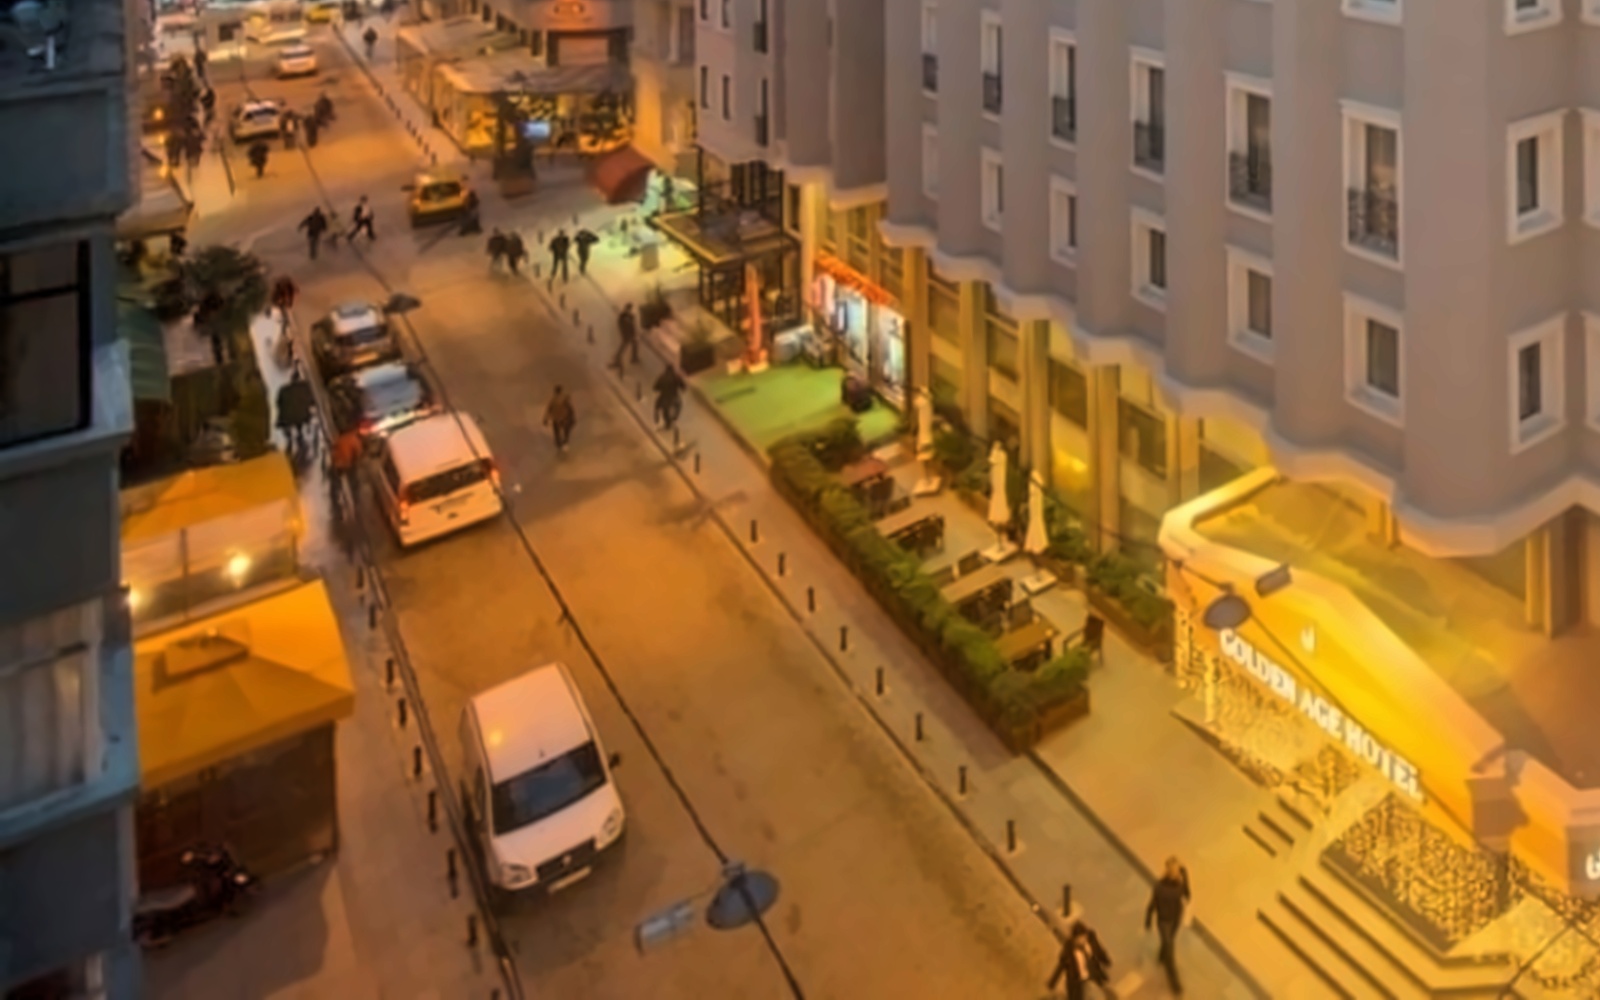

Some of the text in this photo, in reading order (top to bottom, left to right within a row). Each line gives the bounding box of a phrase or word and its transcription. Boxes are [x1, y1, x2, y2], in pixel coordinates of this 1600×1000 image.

[1220, 628, 1424, 801] GOLDEN AGE HOTEL
